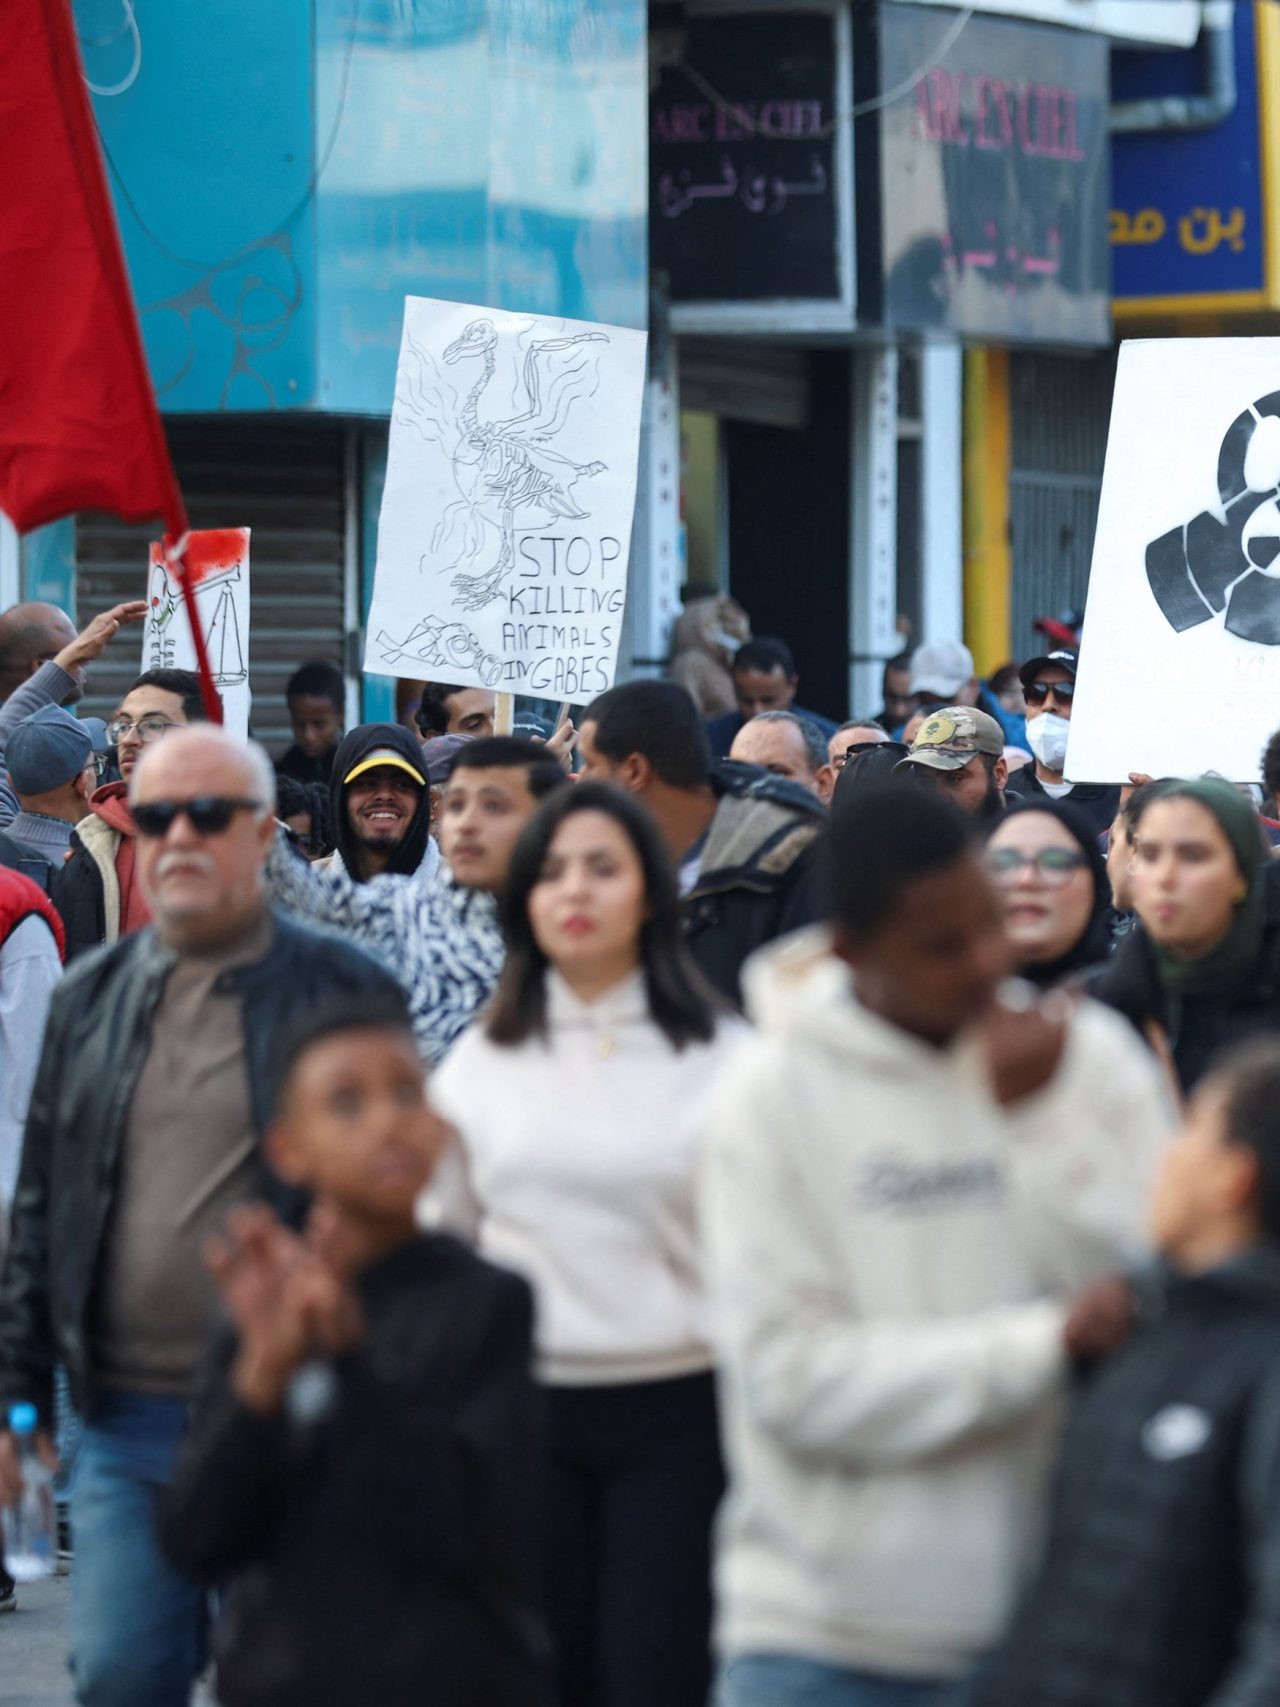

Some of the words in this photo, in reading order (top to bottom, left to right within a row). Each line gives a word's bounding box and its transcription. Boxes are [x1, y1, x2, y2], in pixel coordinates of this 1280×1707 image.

[1178, 206, 1246, 255] بن
[519, 536, 622, 580] STOP
[509, 585, 625, 615] KILLING
[502, 622, 612, 652] ANIMALS
[530, 656, 611, 695] GABES
